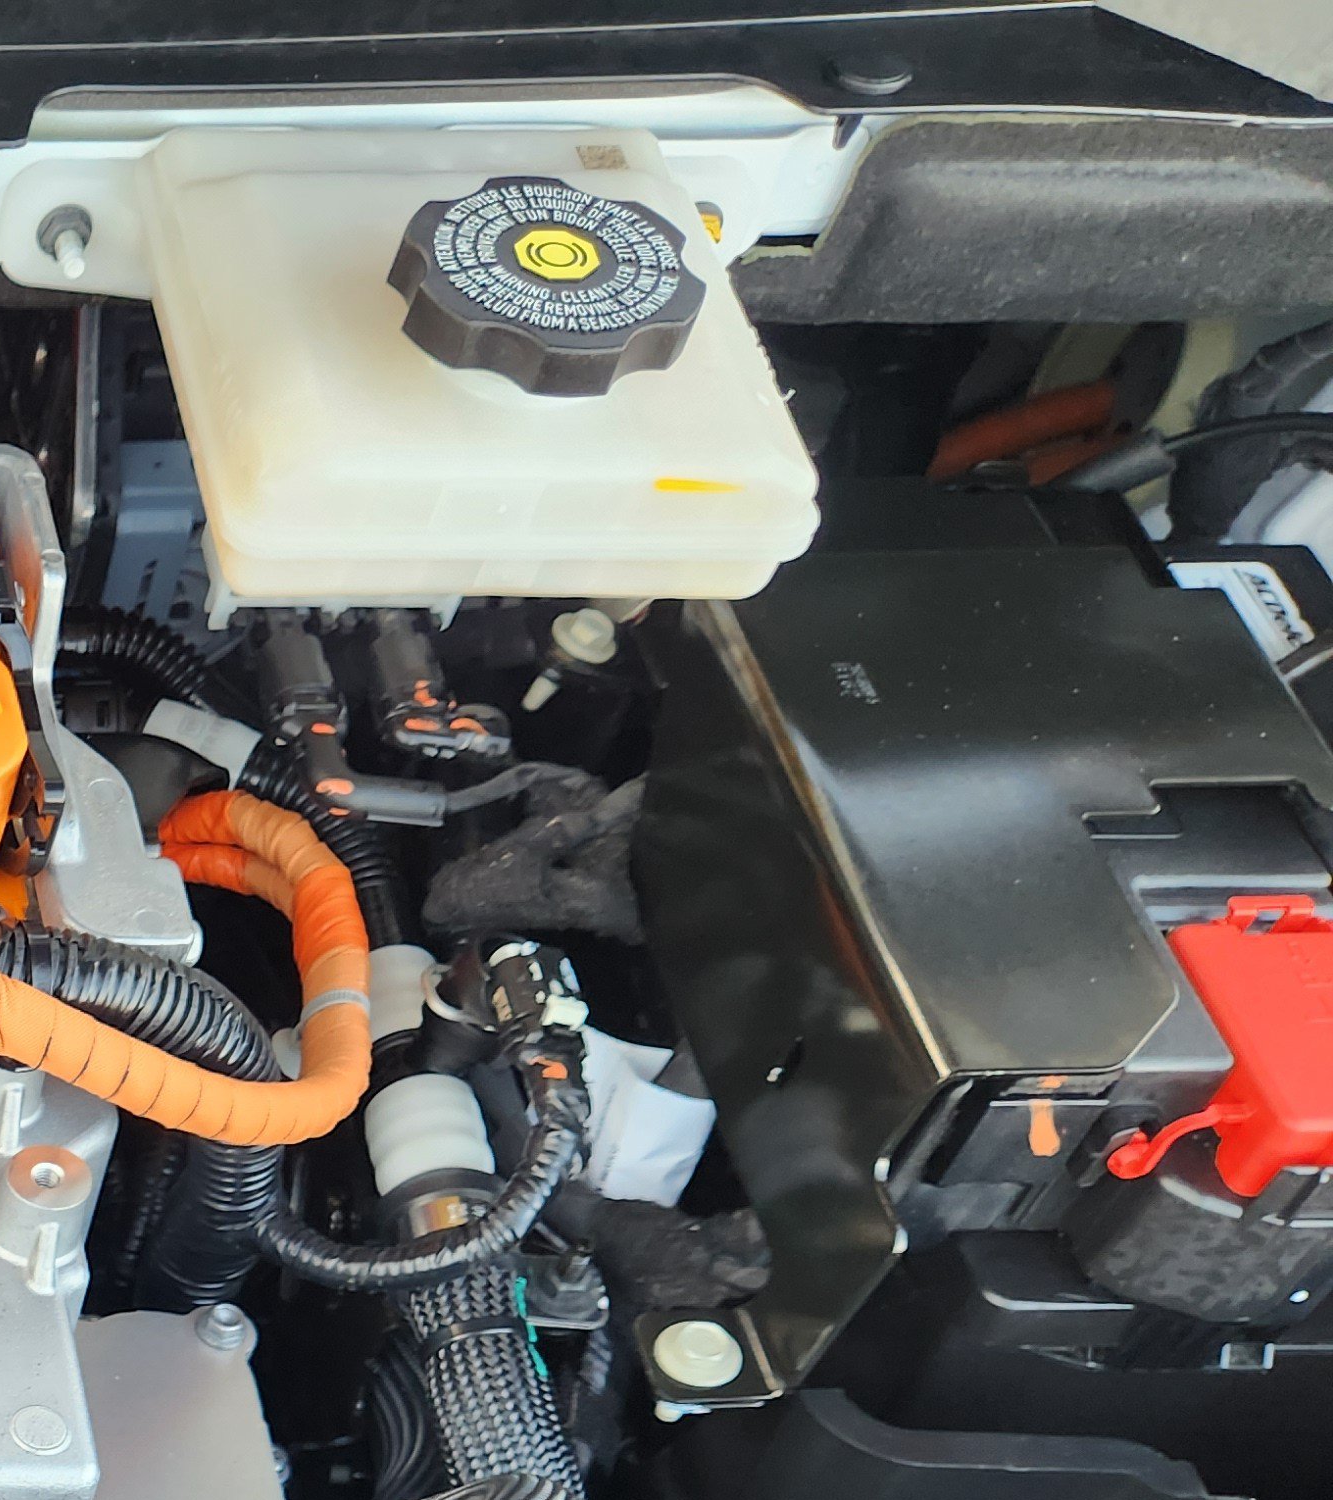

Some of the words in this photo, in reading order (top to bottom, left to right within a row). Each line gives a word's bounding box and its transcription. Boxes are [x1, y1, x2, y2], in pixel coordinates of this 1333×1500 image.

[444, 189, 503, 223] NETTOYER
[500, 185, 523, 199] LE
[522, 184, 593, 205] BOUCHON
[593, 199, 640, 223] AVANT
[634, 220, 656, 235] LA
[478, 202, 509, 220] QUE
[505, 199, 528, 212] DU
[528, 198, 588, 215] LIQUIDE
[587, 208, 609, 222] DE
[605, 217, 645, 244] FREIN
[512, 209, 550, 224] D'UN
[553, 210, 599, 231] BIDON
[448, 272, 484, 298] DOT4
[475, 292, 521, 319] FLUID
[518, 309, 565, 329] FROM
[567, 317, 579, 331] A
[579, 310, 636, 332] SEALED
[468, 267, 495, 287] CAP
[487, 283, 544, 311] BEFORE
[616, 286, 647, 307] USE
[634, 267, 659, 292] ONLY
[561, 285, 610, 303] CLEAN
[601, 265, 637, 296] FILLER
